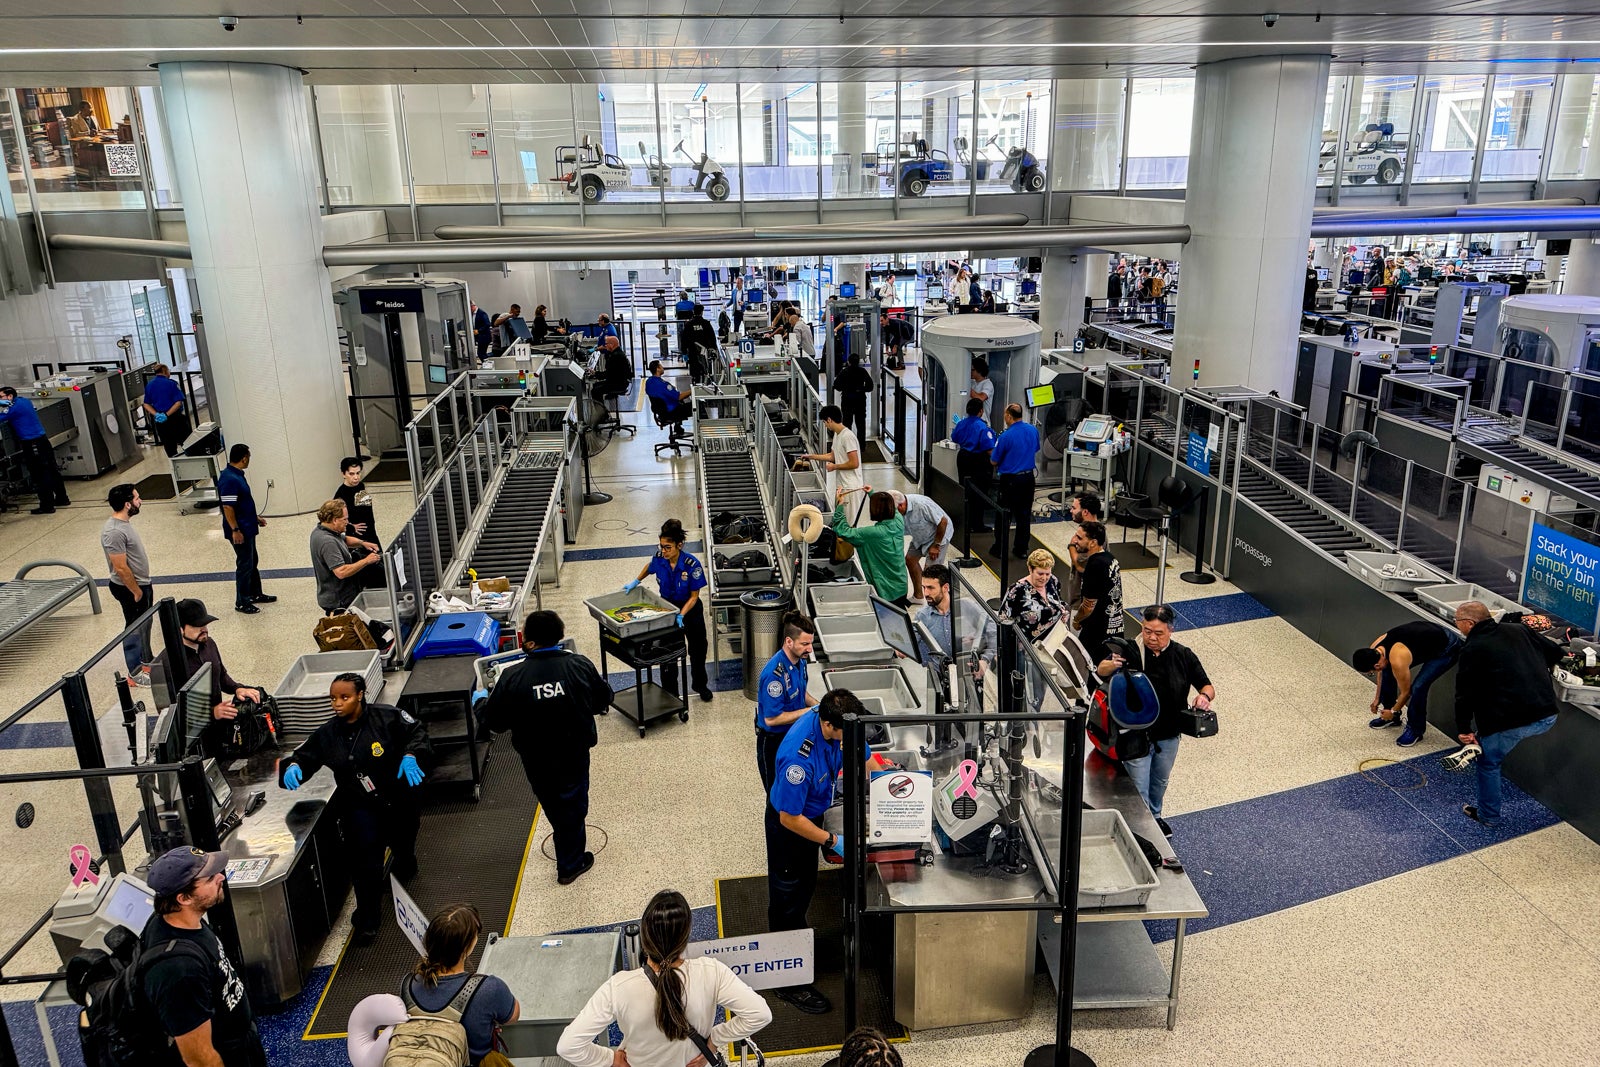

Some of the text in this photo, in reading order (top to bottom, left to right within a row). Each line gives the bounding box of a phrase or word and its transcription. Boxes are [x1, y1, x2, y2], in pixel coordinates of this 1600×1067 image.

[517, 347, 526, 356] 11
[741, 341, 752, 353] 10
[1075, 340, 1083, 352] 9
[1234, 537, 1273, 567] propassage
[1537, 535, 1599, 570] Stack your
[1535, 553, 1595, 588] empty bin
[1531, 566, 1543, 581] to
[1545, 572, 1564, 592] the
[1566, 583, 1596, 606] right
[532, 681, 565, 700] TSA
[704, 945, 746, 955] UNITED
[730, 957, 804, 976] OT ENTER
